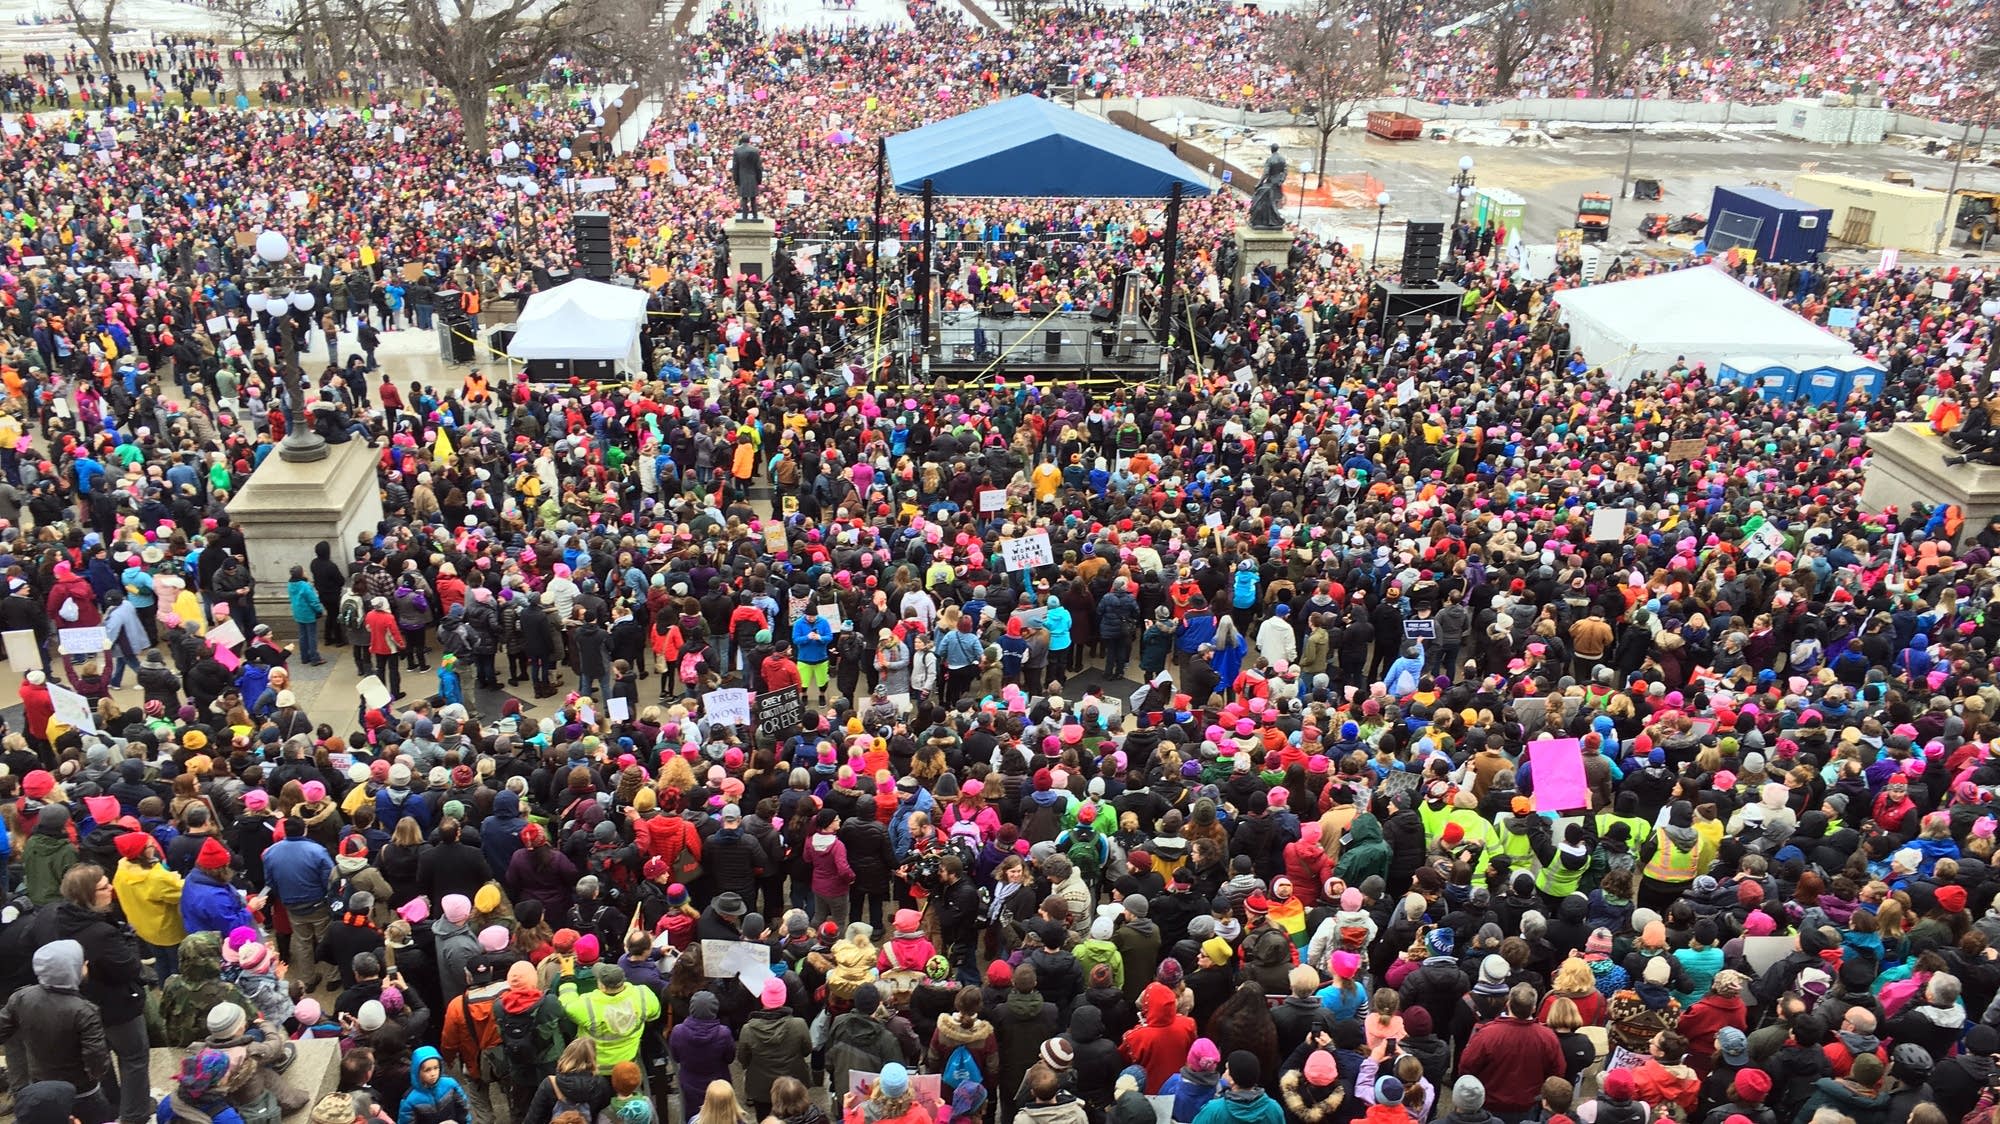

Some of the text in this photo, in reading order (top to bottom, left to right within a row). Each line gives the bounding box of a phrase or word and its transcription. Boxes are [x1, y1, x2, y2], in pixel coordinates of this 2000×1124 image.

[1012, 544, 1040, 555] WOMAN
[711, 692, 743, 704] TRUST
[761, 689, 797, 707] OBEY THE
[763, 708, 802, 734] OR ELSE
